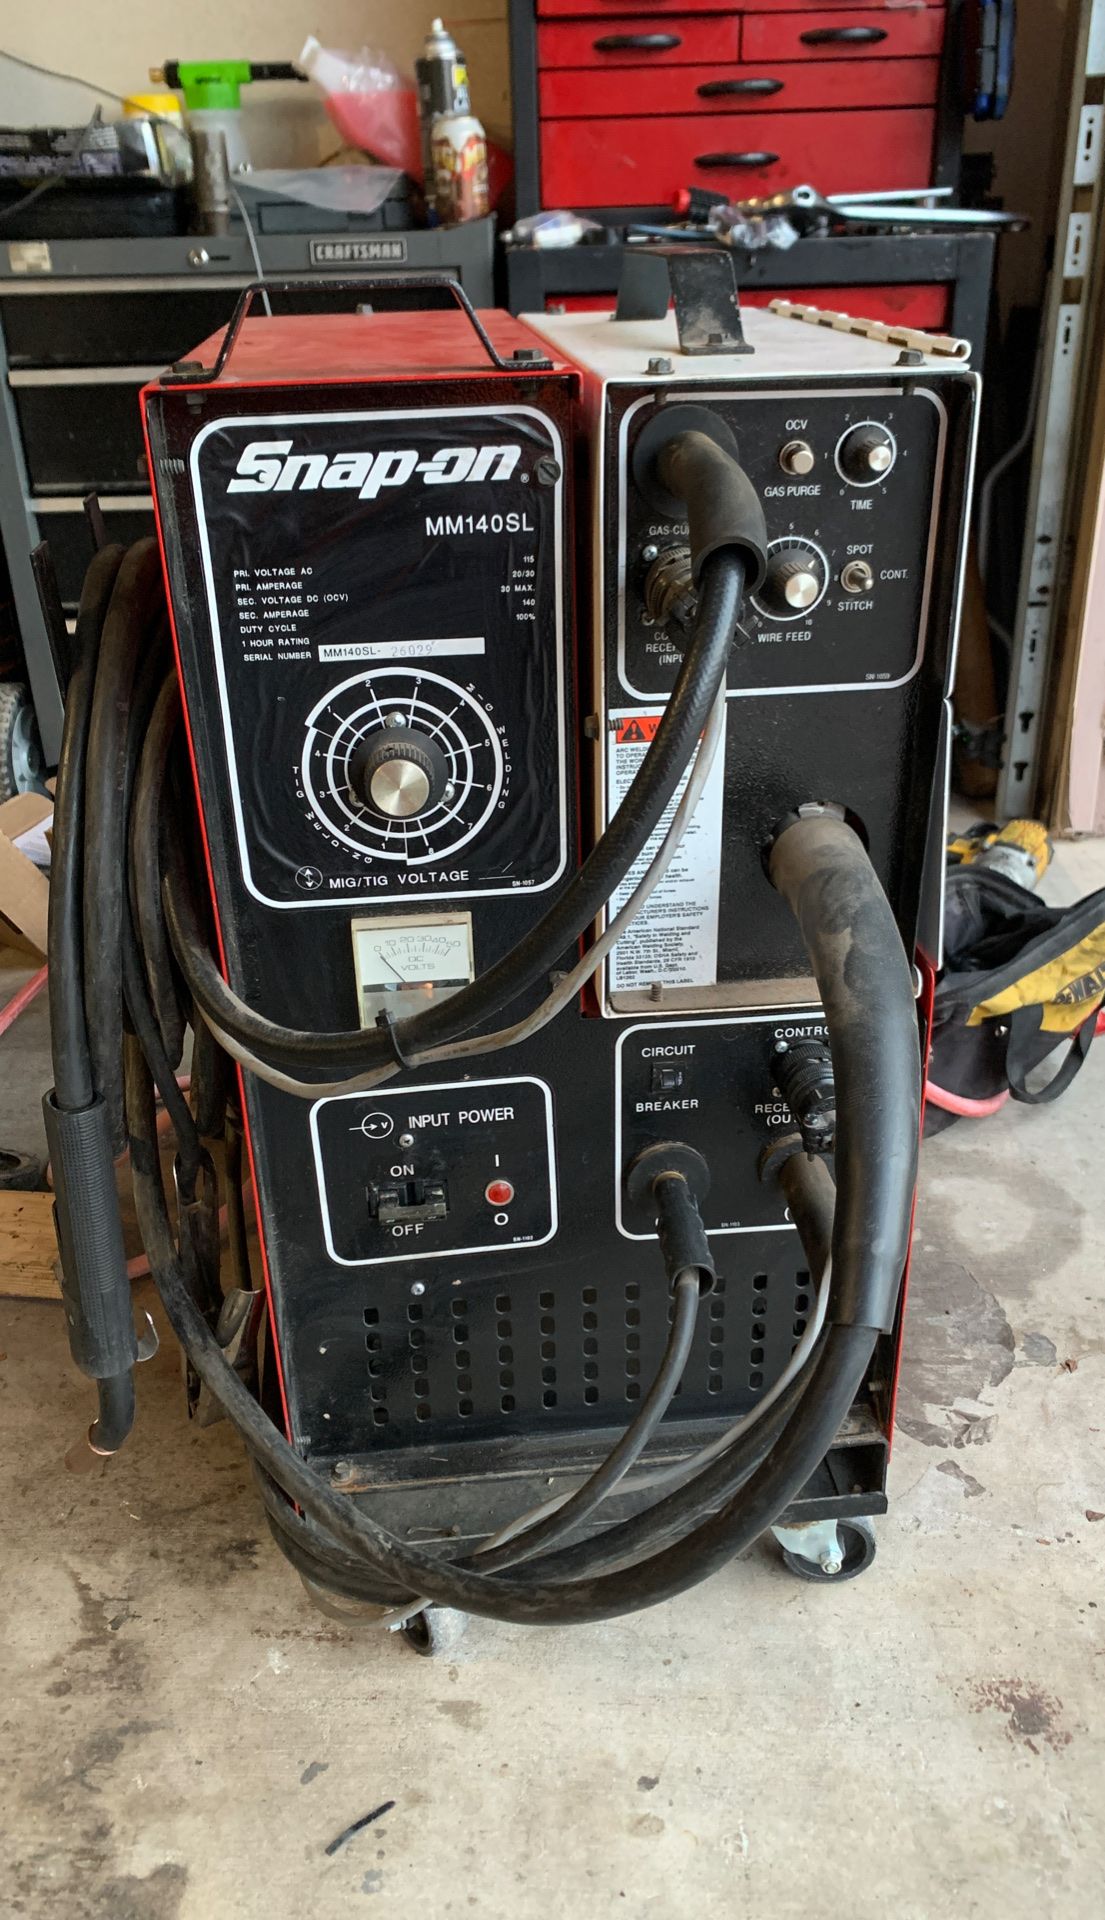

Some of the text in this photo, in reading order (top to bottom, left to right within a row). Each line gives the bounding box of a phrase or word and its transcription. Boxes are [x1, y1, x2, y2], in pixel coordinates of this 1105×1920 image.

[315, 243, 402, 260] CRAFTSMAN
[785, 419, 808, 430] OCV
[764, 484, 821, 497] GAS PURGE
[850, 499, 873, 510] TIME
[425, 513, 534, 536] MM140SL
[846, 544, 874, 555] SPOT
[522, 555, 535, 564] 115
[234, 567, 313, 578] PRI. VOLTAGE AC
[512, 570, 535, 578] 20/30
[880, 569, 908, 580] CONT.
[256, 582, 302, 590] AMPERAGE
[500, 584, 535, 593] 30 MAX.
[238, 594, 348, 606] SEC. VOLTAGE DC (OCV)
[522, 598, 536, 606] 140
[838, 601, 873, 612] STITCH
[239, 610, 310, 620] SEC. AMPERAGE
[516, 612, 536, 621] 100%
[240, 624, 296, 634] DUTY CYCLE
[250, 638, 274, 646] HOUR
[278, 638, 310, 646] RATING
[758, 631, 812, 643] WIRE FEED
[244, 654, 273, 662] SERIAL
[278, 652, 312, 660] NUMBER
[466, 683, 494, 712] MIG
[315, 750, 320, 758] 4
[496, 725, 512, 809] WELDING
[292, 766, 304, 798] TIG
[486, 784, 492, 792] 6
[320, 790, 325, 798] 3
[344, 824, 350, 832] 2
[467, 822, 473, 830] 7
[305, 812, 372, 864] WELDING
[381, 842, 386, 850] 1
[329, 870, 470, 889] MIG/TIG VOLTAGE
[642, 1045, 696, 1058] CIRCUIT
[636, 1100, 699, 1113] BREAKER
[408, 1112, 450, 1129] INPUT
[458, 1107, 514, 1124] POWER
[390, 1164, 415, 1177] ON
[392, 1223, 424, 1237] OFF
